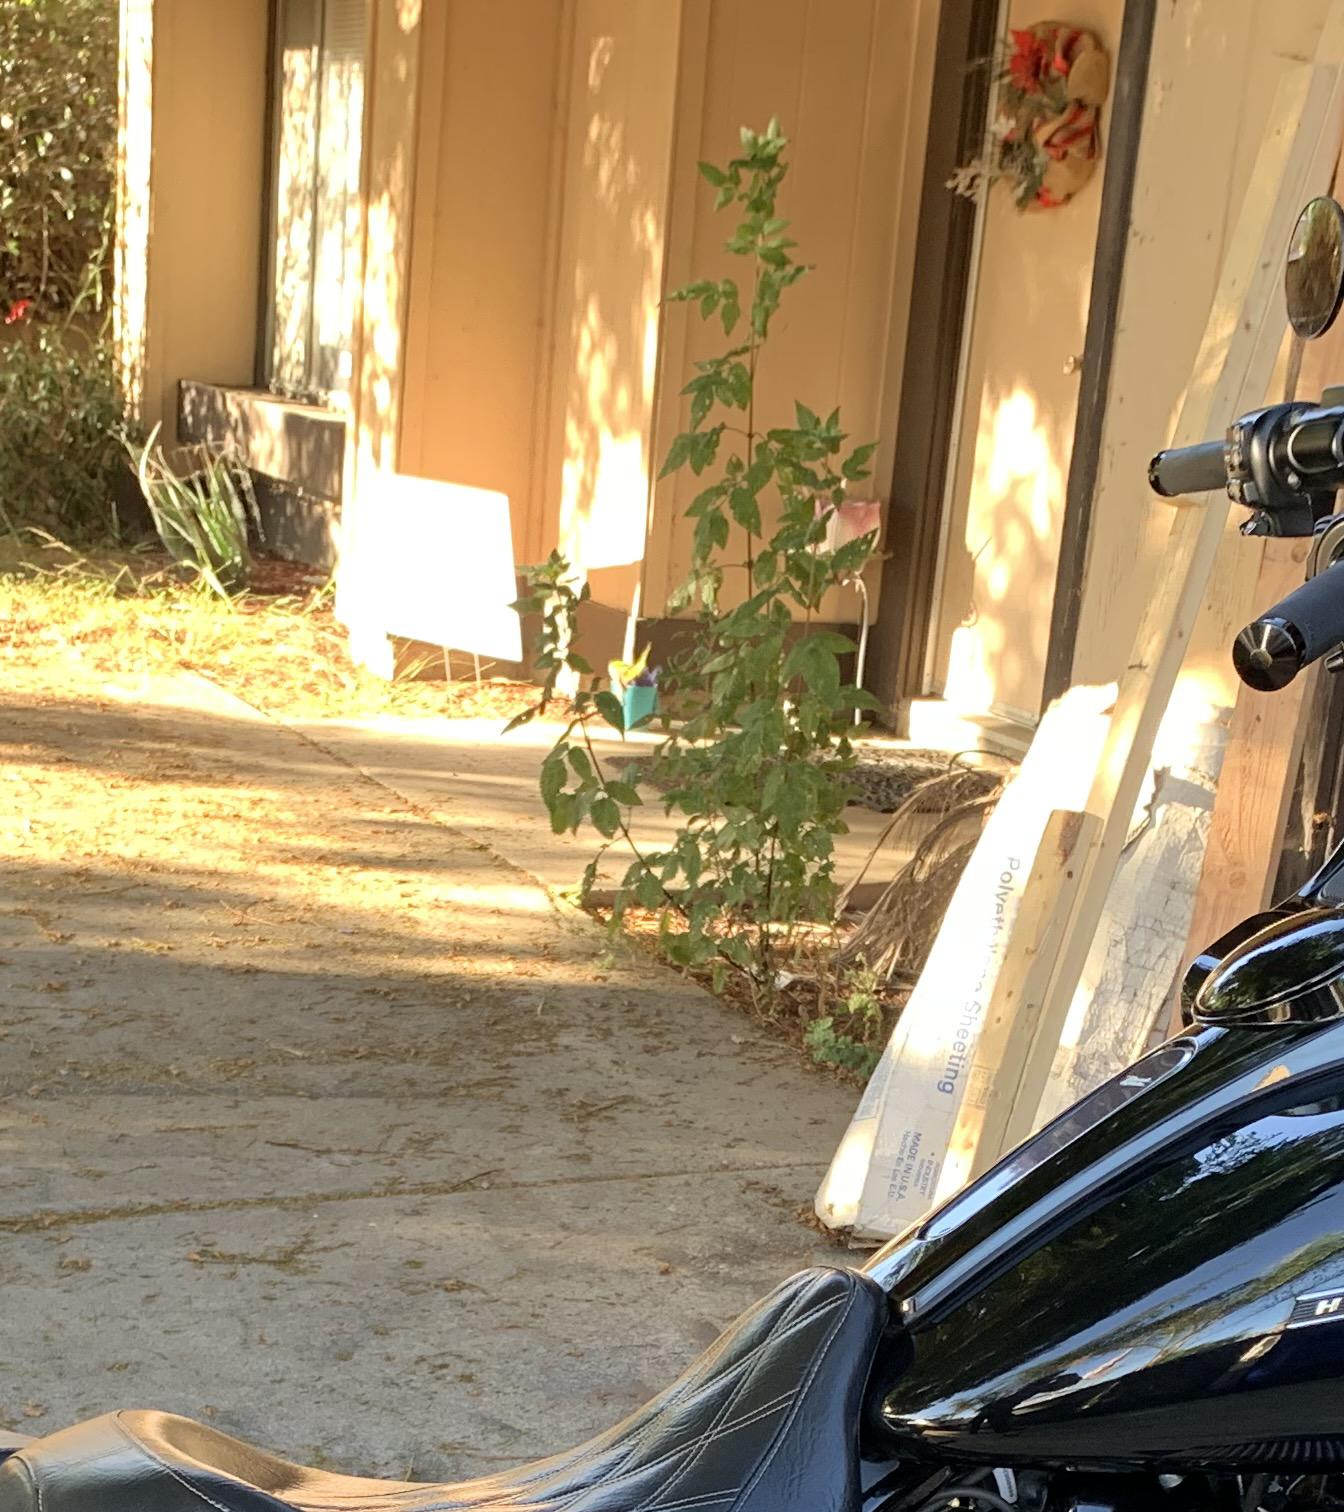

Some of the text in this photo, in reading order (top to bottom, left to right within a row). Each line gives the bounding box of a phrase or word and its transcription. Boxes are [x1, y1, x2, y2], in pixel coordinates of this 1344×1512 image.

[937, 856, 1021, 1095] Polyeth Sheeting
[907, 1131, 923, 1160] MADE
